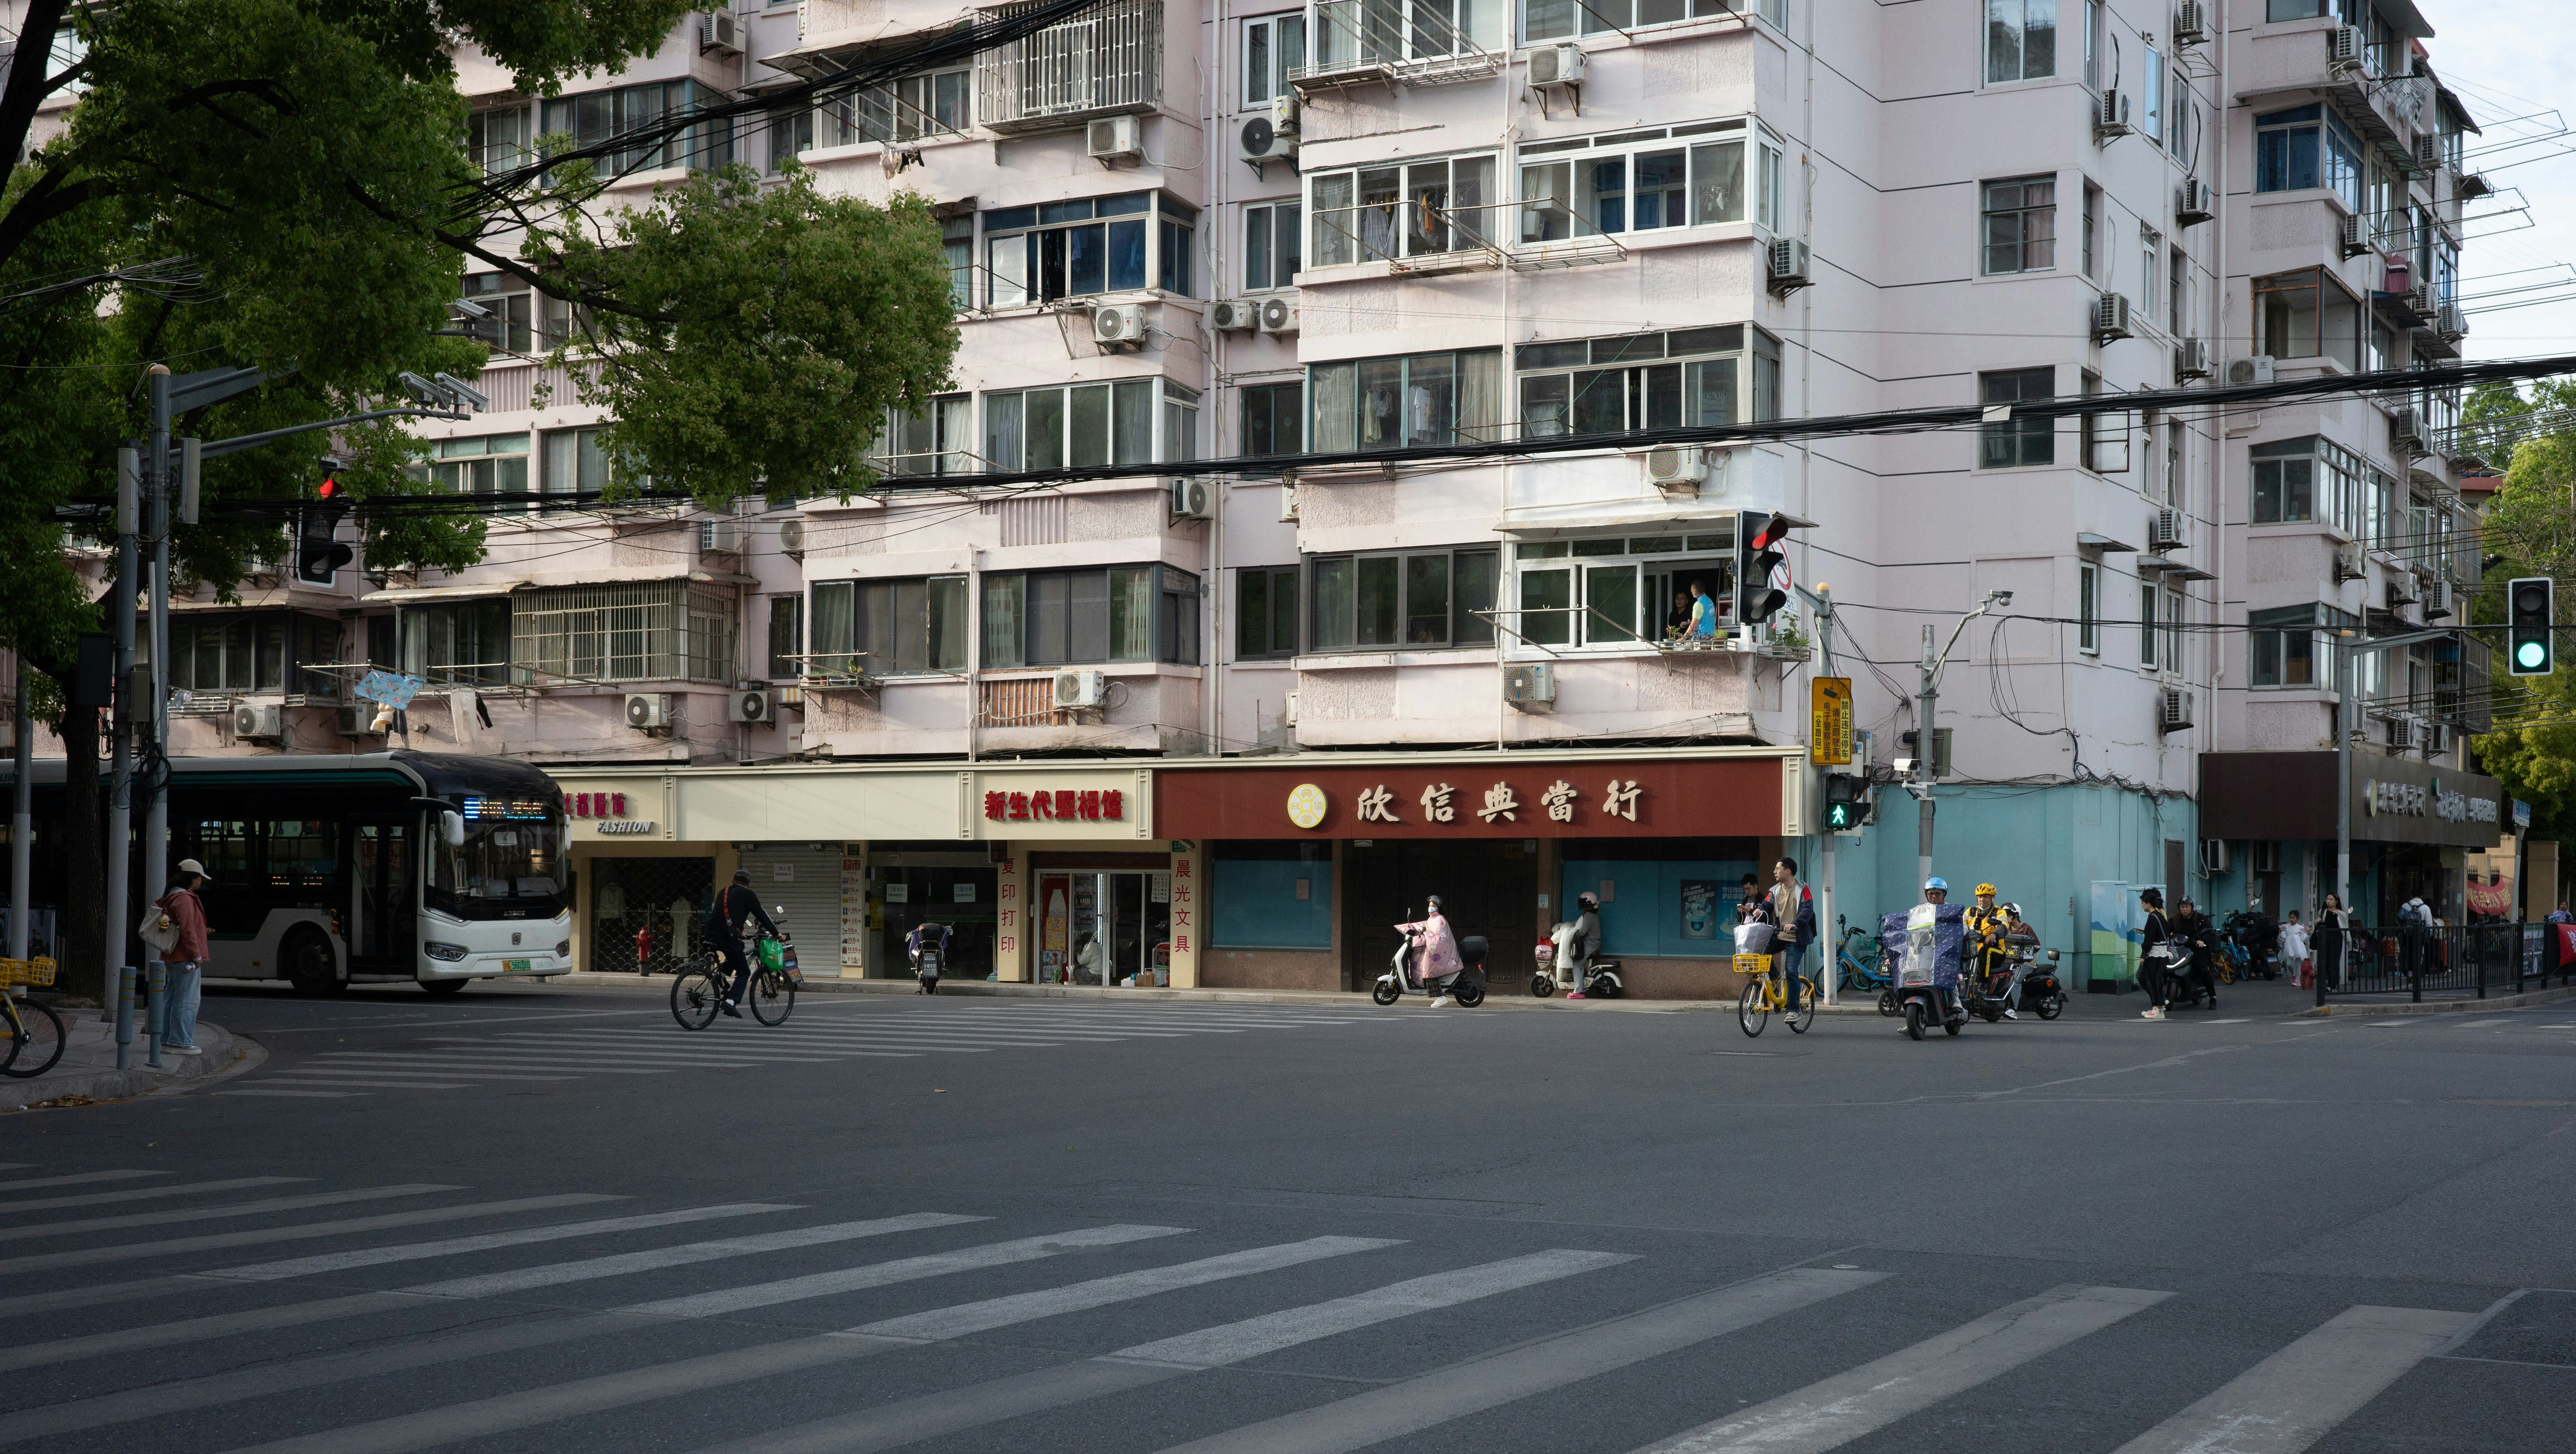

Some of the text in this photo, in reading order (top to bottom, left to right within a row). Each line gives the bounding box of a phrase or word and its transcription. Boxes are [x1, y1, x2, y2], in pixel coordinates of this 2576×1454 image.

[985, 789, 1123, 820] 新生代照相馆
[1358, 779, 1642, 823] 欣信典當行
[595, 822, 652, 832] FASHION
[843, 860, 860, 870] 超市
[1001, 858, 1016, 954] 复印打印
[1174, 860, 1192, 953] 晨光文具
